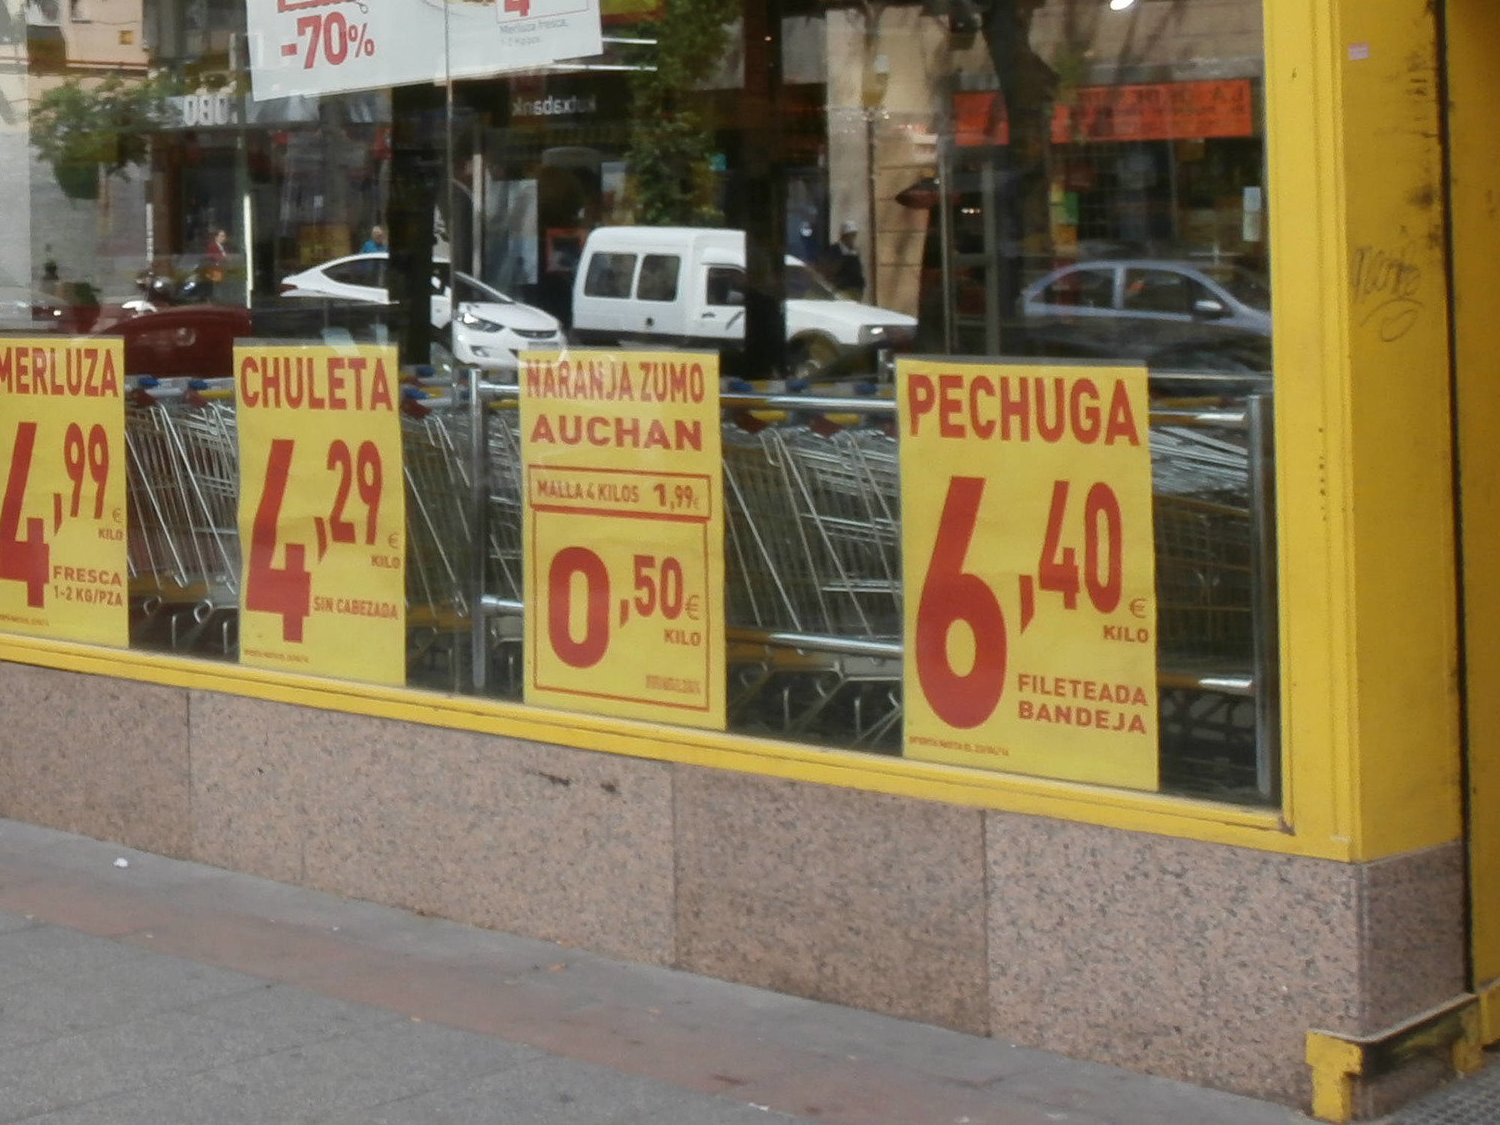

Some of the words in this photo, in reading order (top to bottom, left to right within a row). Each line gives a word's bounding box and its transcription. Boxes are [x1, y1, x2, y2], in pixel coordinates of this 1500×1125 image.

[281, 11, 375, 70] -70%
[240, 356, 393, 411] CHULETA
[526, 359, 634, 401] NARANJA
[640, 361, 705, 404] ZUMO
[907, 373, 1140, 446] PECHUGA
[530, 414, 703, 451] AUCHAN
[537, 479, 583, 500] MALLA
[598, 482, 640, 504] KILOS
[98, 528, 124, 541] KILO
[371, 554, 400, 570] KILO
[53, 565, 123, 587] FRESCA
[54, 585, 73, 601] 1-2
[76, 588, 124, 607] KG/PZA
[313, 596, 334, 614] SIN
[664, 628, 702, 647] KILO
[1102, 624, 1150, 644] KILO
[1017, 674, 1149, 707] FILETEADA
[1018, 700, 1147, 734] BANDEJA
